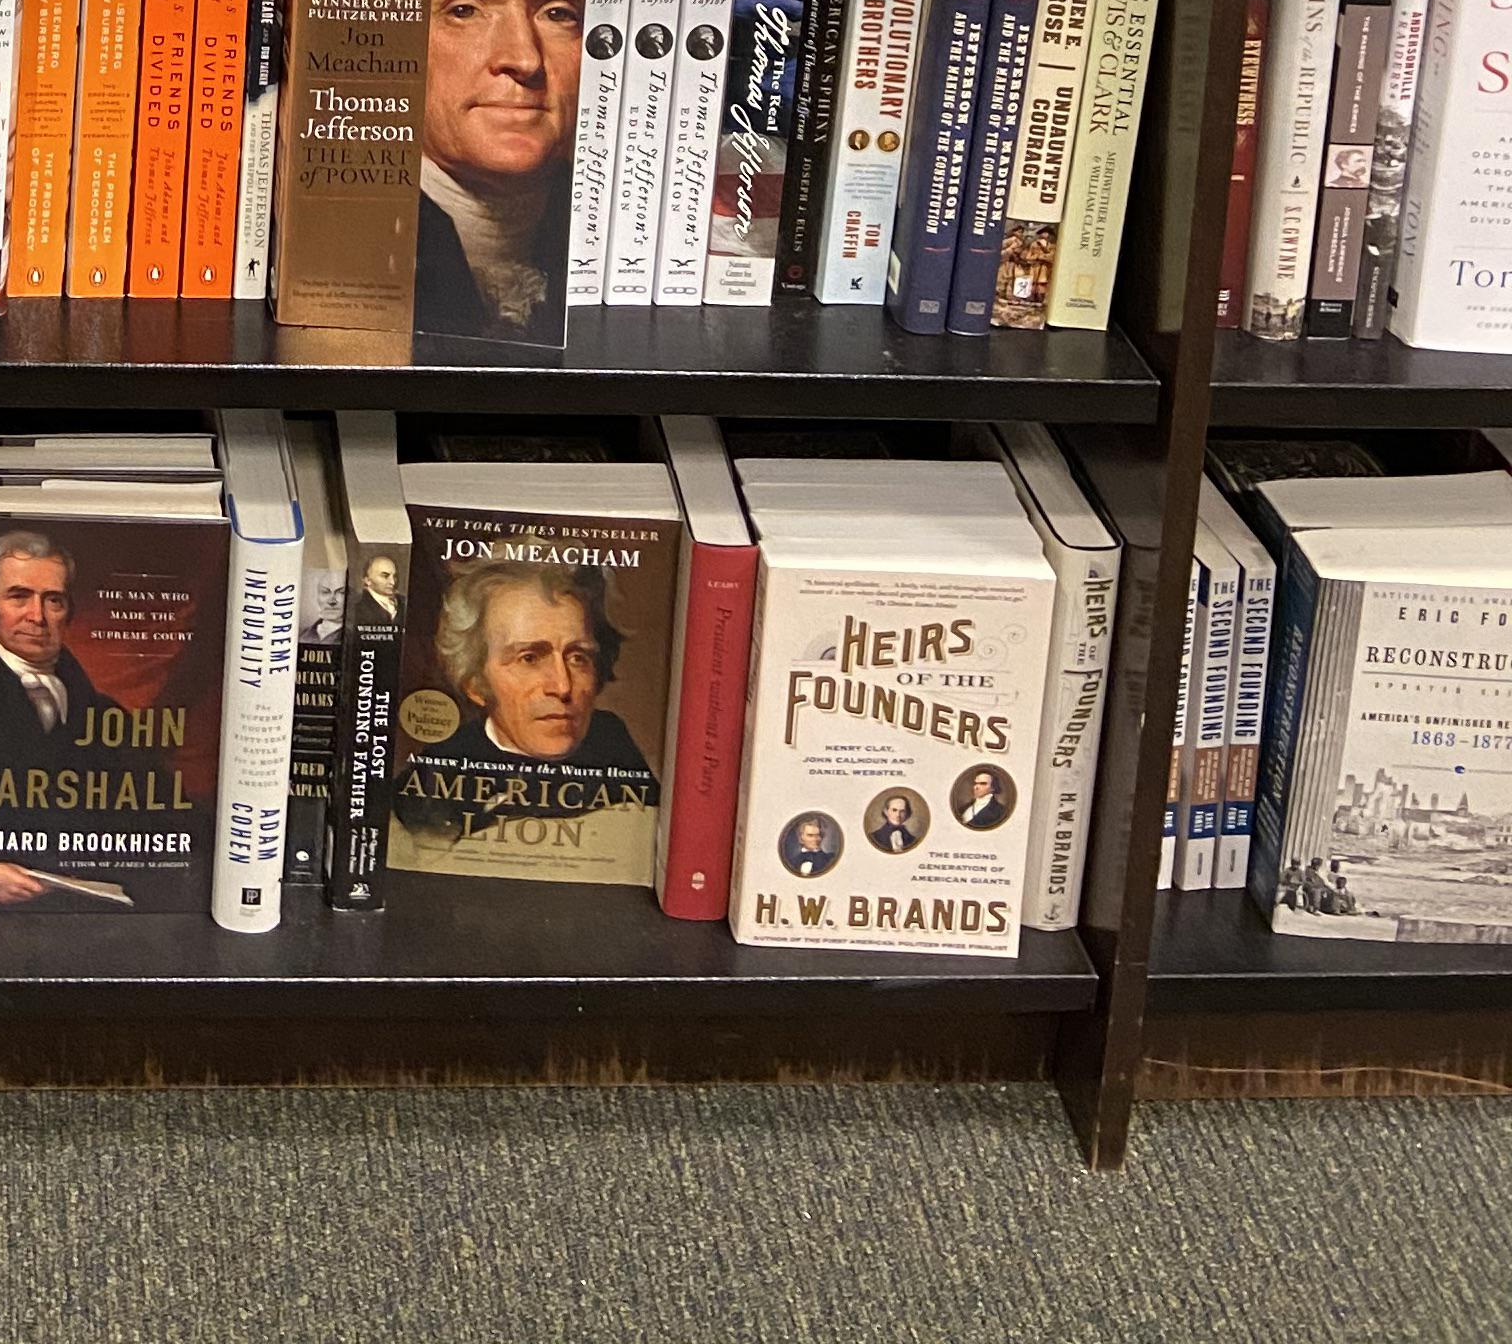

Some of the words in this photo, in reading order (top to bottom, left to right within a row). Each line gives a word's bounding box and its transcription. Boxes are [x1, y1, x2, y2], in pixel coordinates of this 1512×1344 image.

[308, 8, 377, 20] PULITZER
[381, 11, 423, 21] PRIZE
[396, 0, 422, 9] THE
[340, 26, 385, 48] Jon
[855, 0, 886, 91] BROTHERS
[306, 51, 420, 75] Meacham
[309, 88, 409, 113] Thomas
[299, 118, 414, 142] Jefferson
[1021, 98, 1050, 190] COURAGE
[1040, 86, 1073, 205] UNDAUNTED
[441, 539, 494, 562] JON
[504, 543, 641, 568] MEACHAM
[96, 590, 123, 601] THE
[128, 591, 156, 601] MAN
[161, 592, 189, 602] WHO
[110, 611, 146, 621] MADE
[151, 611, 176, 621] THE
[239, 569, 267, 688] INEQUALITY
[1399, 607, 1460, 624] ERIC
[90, 630, 148, 641] SUPREME
[154, 632, 193, 641] COURT
[270, 584, 295, 676] SUPREME
[841, 615, 975, 675] HEIRS
[897, 672, 935, 687] OF
[940, 675, 995, 688] THE
[785, 670, 1010, 750] FOUNDERS
[74, 707, 186, 747] JOHN
[400, 772, 650, 812] AMERICAN
[58, 829, 192, 852] BROOKHISER
[461, 812, 585, 848] LION
[848, 896, 1008, 933] BRANDS
